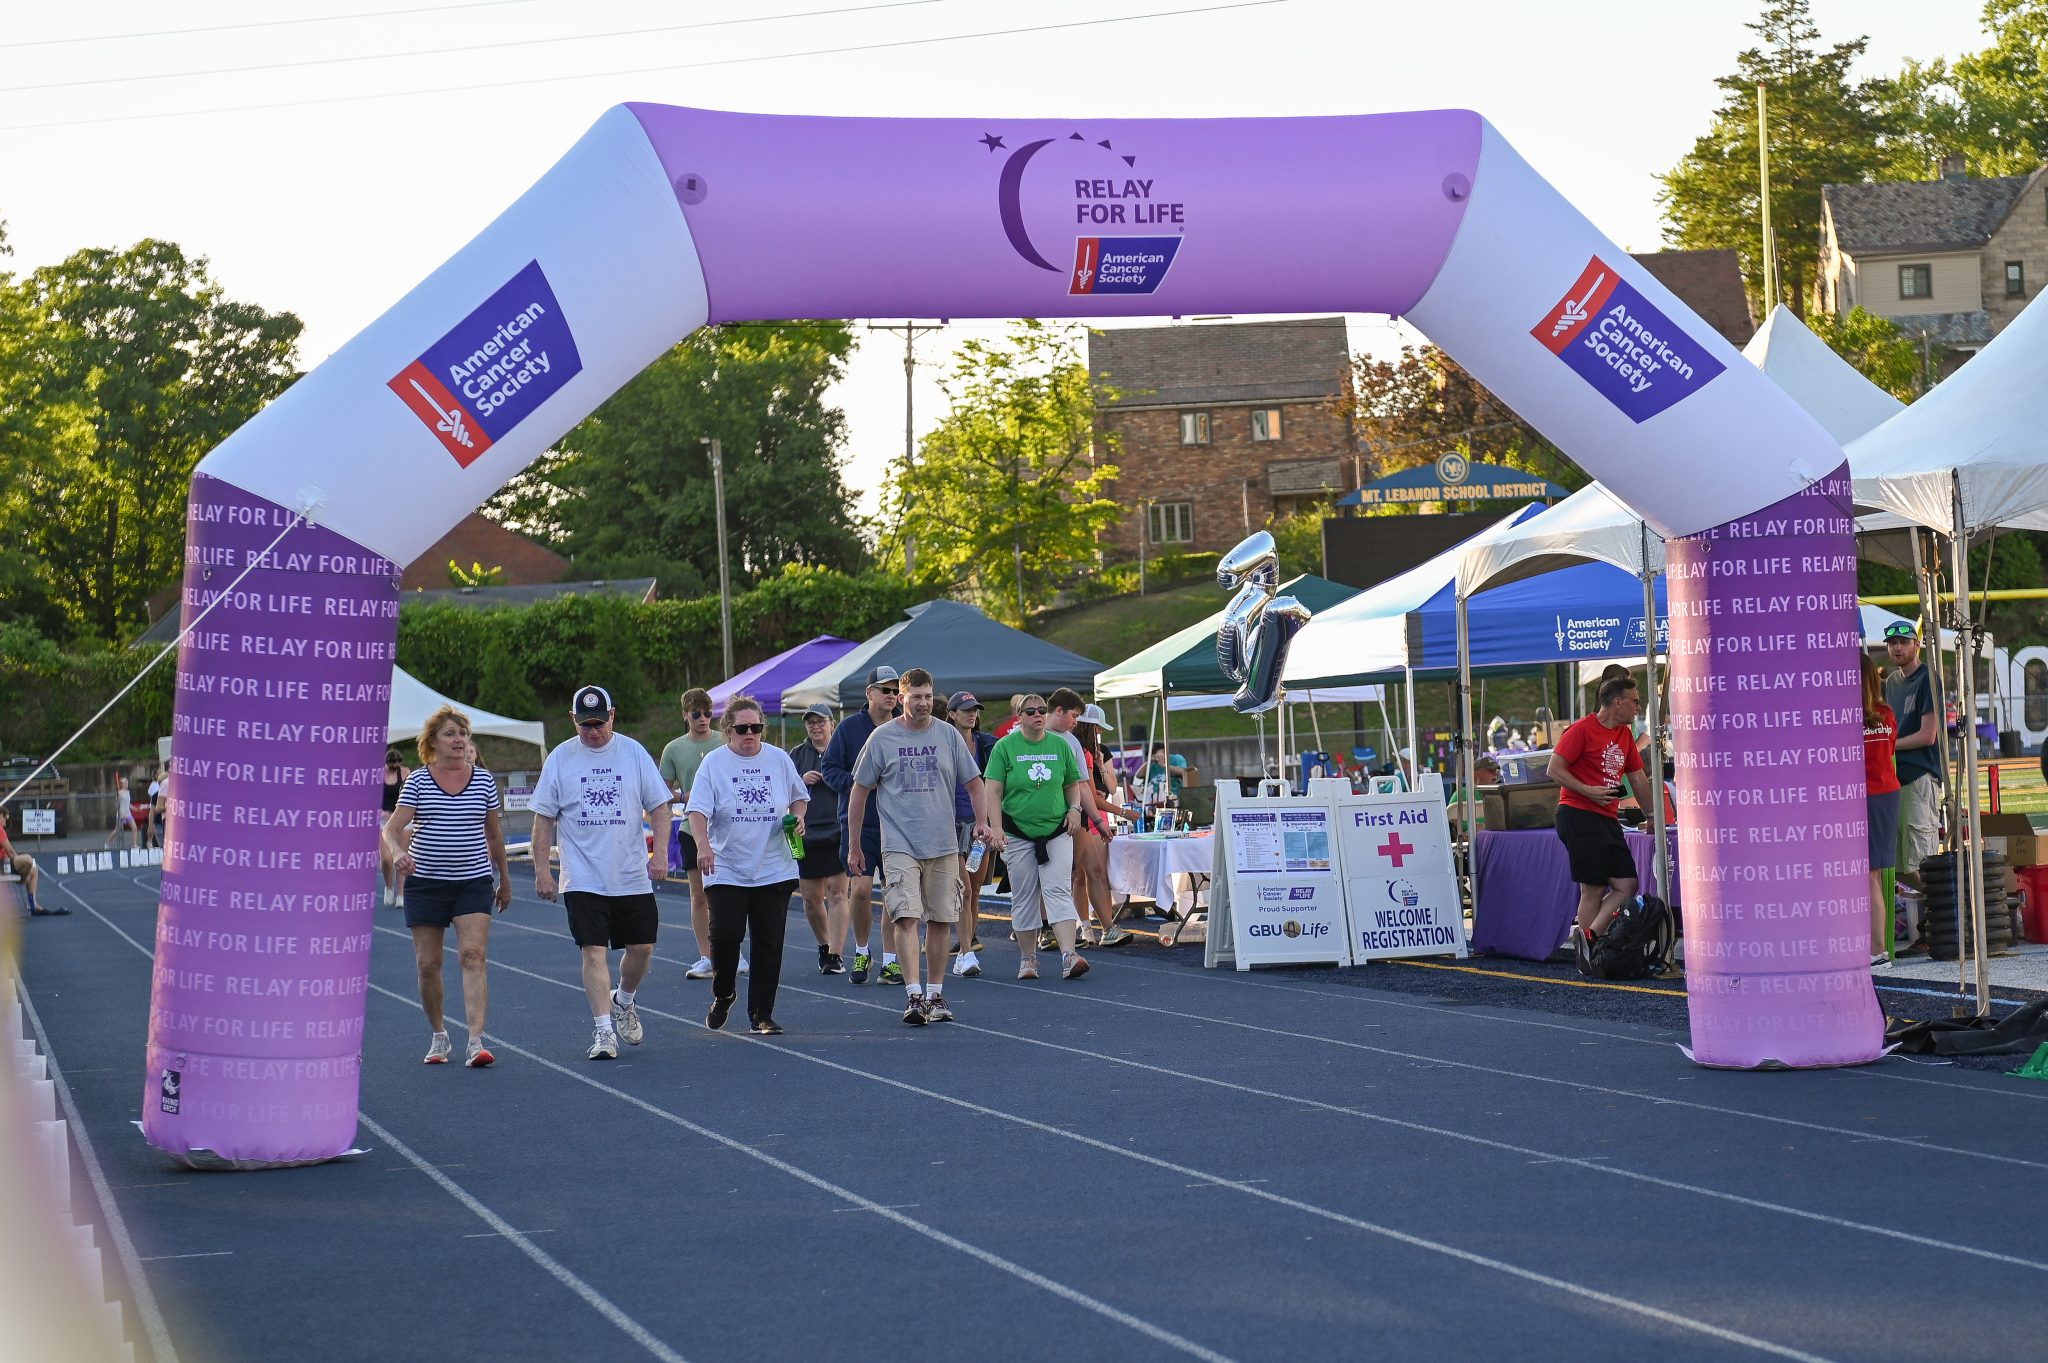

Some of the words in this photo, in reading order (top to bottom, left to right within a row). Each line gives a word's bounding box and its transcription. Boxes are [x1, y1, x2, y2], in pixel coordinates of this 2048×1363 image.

[1075, 179, 1154, 199] RELAY
[1077, 203, 1126, 224] FOR
[1135, 203, 1185, 224] LIFE
[1101, 264, 1146, 274] Cancer
[1102, 253, 1164, 264] American
[1099, 273, 1146, 285] Society
[449, 302, 546, 386] American
[1599, 317, 1662, 374] Cancer
[1609, 304, 1694, 381] American
[462, 338, 532, 399] Cancer
[1584, 331, 1653, 393] Society
[475, 351, 551, 417] Society
[1361, 489, 1382, 503] MT.
[1385, 487, 1440, 501] LEBANON
[1443, 485, 1490, 499] SCHOOL
[1493, 482, 1547, 497] DISTRICT
[229, 506, 265, 525] FOR
[1730, 520, 1787, 537] RELAY
[1794, 518, 1825, 534] FOR
[1830, 518, 1849, 534] LIFE
[203, 547, 234, 566] LIFE
[246, 550, 312, 572] RELAY
[320, 555, 356, 574] FOR
[362, 558, 389, 575] LIFE
[1713, 560, 1746, 576] FOR
[1753, 558, 1791, 574] LIFE
[1803, 556, 1844, 572] RELAY
[224, 590, 261, 610] FOR
[269, 595, 311, 614] LIFE
[325, 598, 378, 616] RELAY
[1691, 599, 1721, 616] LIFE
[1733, 596, 1790, 614] RELAY
[1797, 595, 1828, 611] FOR
[1832, 594, 1852, 609] LIFE
[1567, 617, 1620, 629] American
[1567, 629, 1608, 639] Cancer
[1718, 637, 1752, 653] FOR
[1759, 635, 1796, 651] LIFE
[1807, 632, 1848, 649] RELAY
[198, 632, 229, 651] LIFE
[242, 636, 307, 656] RELAY
[315, 640, 351, 658] FOR
[357, 642, 384, 659] LIFE
[1569, 639, 1611, 651] Society
[221, 677, 258, 696] FOR
[266, 680, 308, 699] LIFE
[322, 684, 376, 701] RELAY
[1696, 676, 1726, 692] LIFE
[1738, 673, 1795, 690] RELAY
[1802, 671, 1833, 687] FOR
[1837, 670, 1856, 686] LIFE
[1723, 713, 1757, 729] FOR
[1764, 711, 1801, 727] LIFE
[1813, 708, 1853, 725] RELAY
[194, 717, 225, 736] LIFE
[238, 721, 304, 741] RELAY
[311, 726, 347, 743] FOR
[353, 727, 379, 743] LIFE
[898, 745, 937, 757] RELAY
[1701, 752, 1732, 767] LIFE
[1744, 749, 1801, 766] RELAY
[1808, 747, 1838, 764] FOR
[1842, 746, 1861, 762] LIFE
[217, 762, 254, 781] FOR
[262, 766, 304, 784] LIFE
[318, 768, 368, 785] RELAY
[899, 771, 937, 788] LIFE
[1728, 789, 1763, 805] FOR
[1770, 787, 1807, 804] LIFE
[1818, 784, 1860, 801] RELAY
[189, 802, 221, 821] LIFE
[234, 806, 300, 826] RELAY
[307, 811, 343, 827] FOR
[348, 810, 373, 827] LIFE
[1354, 812, 1394, 827] First
[1398, 809, 1428, 825] Aid
[1707, 828, 1738, 843] LIFE
[1749, 826, 1806, 843] RELAY
[1813, 823, 1843, 840] FOR
[1847, 821, 1864, 837] LIFE
[213, 847, 250, 867] FOR
[259, 851, 301, 869] LIFE
[314, 852, 364, 870] RELAY
[1734, 866, 1769, 881] FOR
[1776, 863, 1813, 880] LIFE
[1824, 860, 1863, 877] RELAY
[185, 887, 218, 906] LIFE
[231, 892, 296, 911] RELAY
[303, 895, 338, 912] FOR
[344, 893, 368, 911] LIFE
[1711, 904, 1743, 919] LIFE
[1755, 902, 1812, 919] RELAY
[1819, 899, 1848, 916] FOR
[1851, 897, 1868, 913] LIFE
[1375, 908, 1431, 928] WELCOME
[1249, 924, 1282, 937] GBU
[1302, 923, 1329, 938] Life
[1362, 926, 1455, 950] REGISTRATION
[208, 932, 247, 952] FOR
[255, 936, 297, 954] LIFE
[310, 936, 358, 954] RELAY
[1739, 942, 1774, 957] FOR
[1781, 939, 1818, 956] LIFE
[1829, 937, 1865, 953] RELAY
[180, 971, 214, 992] LIFE
[227, 977, 292, 996] RELAY
[299, 979, 334, 996] FOR
[339, 976, 362, 995] LIFE
[205, 1017, 243, 1036] FOR
[251, 1021, 293, 1038] LIFE
[306, 1019, 356, 1038] RELAY
